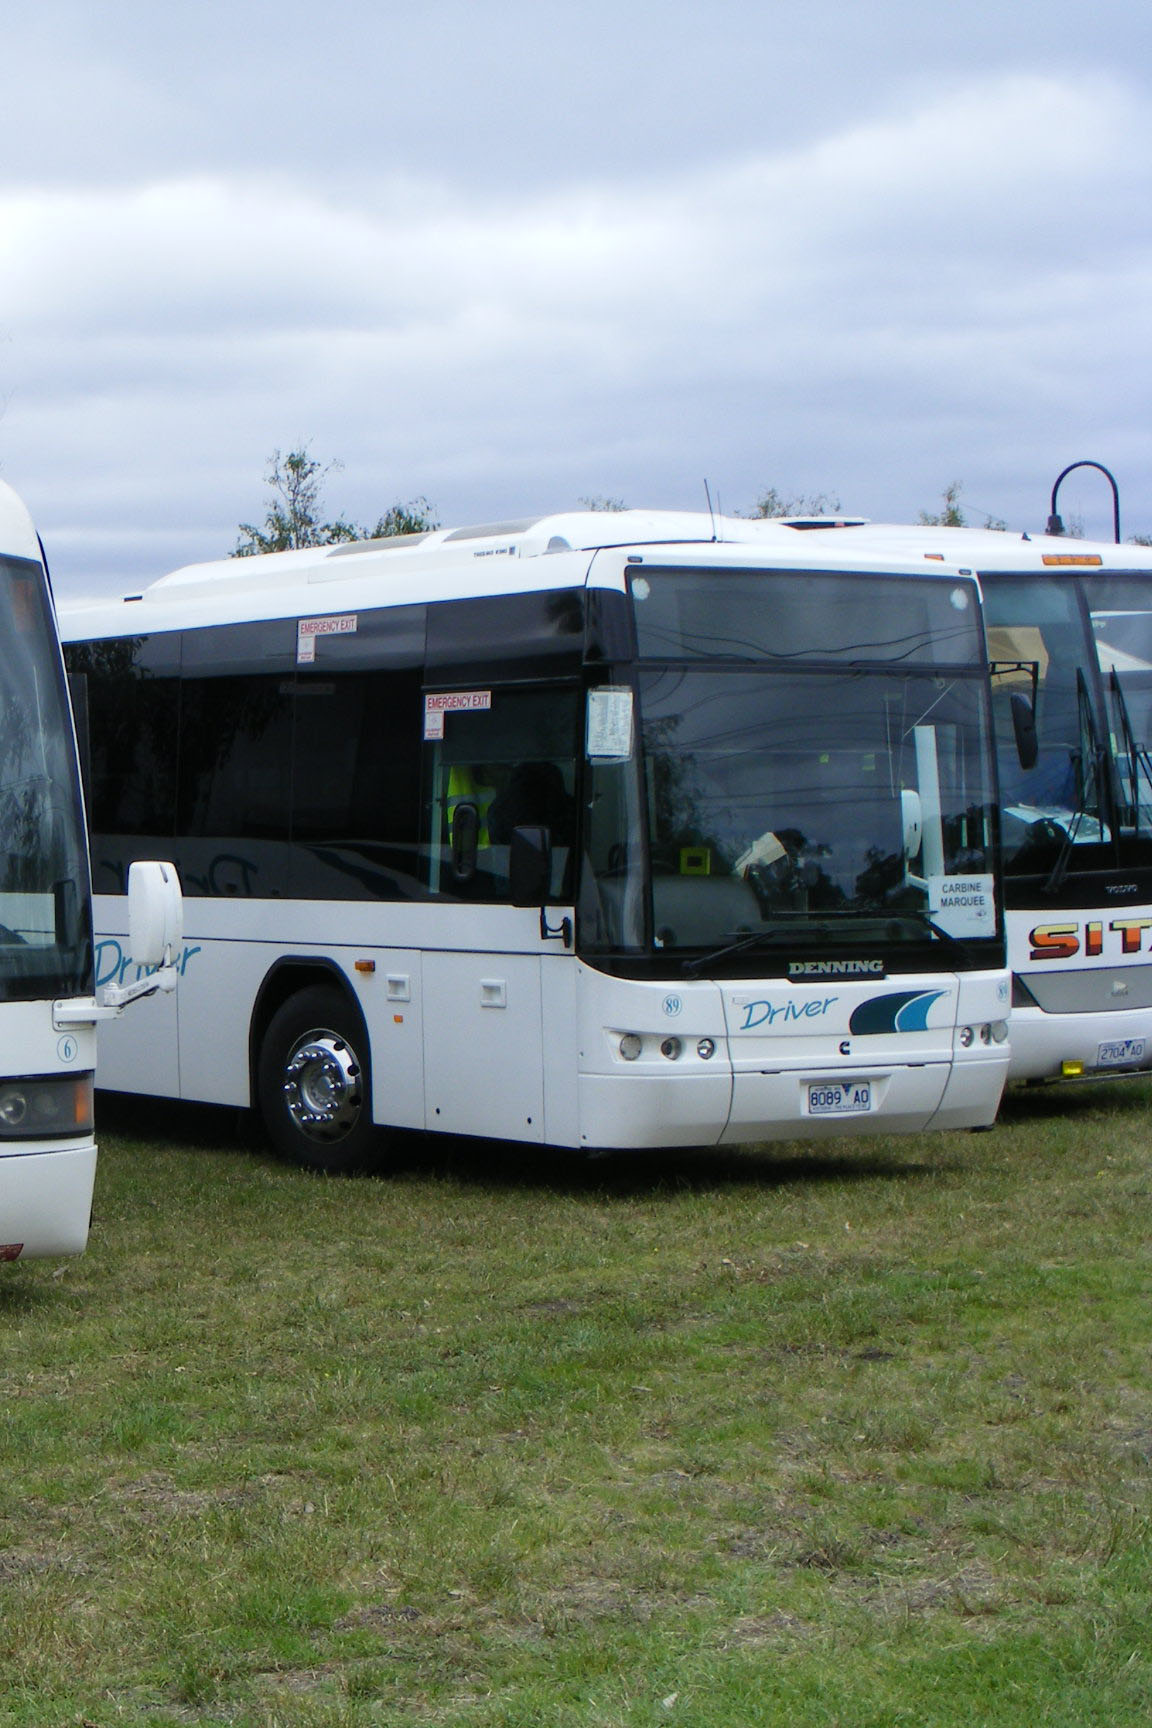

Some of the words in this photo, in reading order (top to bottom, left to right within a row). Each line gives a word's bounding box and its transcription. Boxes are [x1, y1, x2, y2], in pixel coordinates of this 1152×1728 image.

[300, 620, 339, 634] EMERGENCY
[340, 618, 355, 631] EXIT
[427, 696, 472, 709] EMERGENCY
[472, 694, 489, 707] EXIT
[942, 882, 982, 894] CARBINE
[941, 896, 985, 907] MARQUEE
[1029, 917, 1152, 961] SIT
[788, 960, 885, 975] DENNING
[739, 997, 840, 1030] Driver
[810, 1091, 842, 1106] 8089
